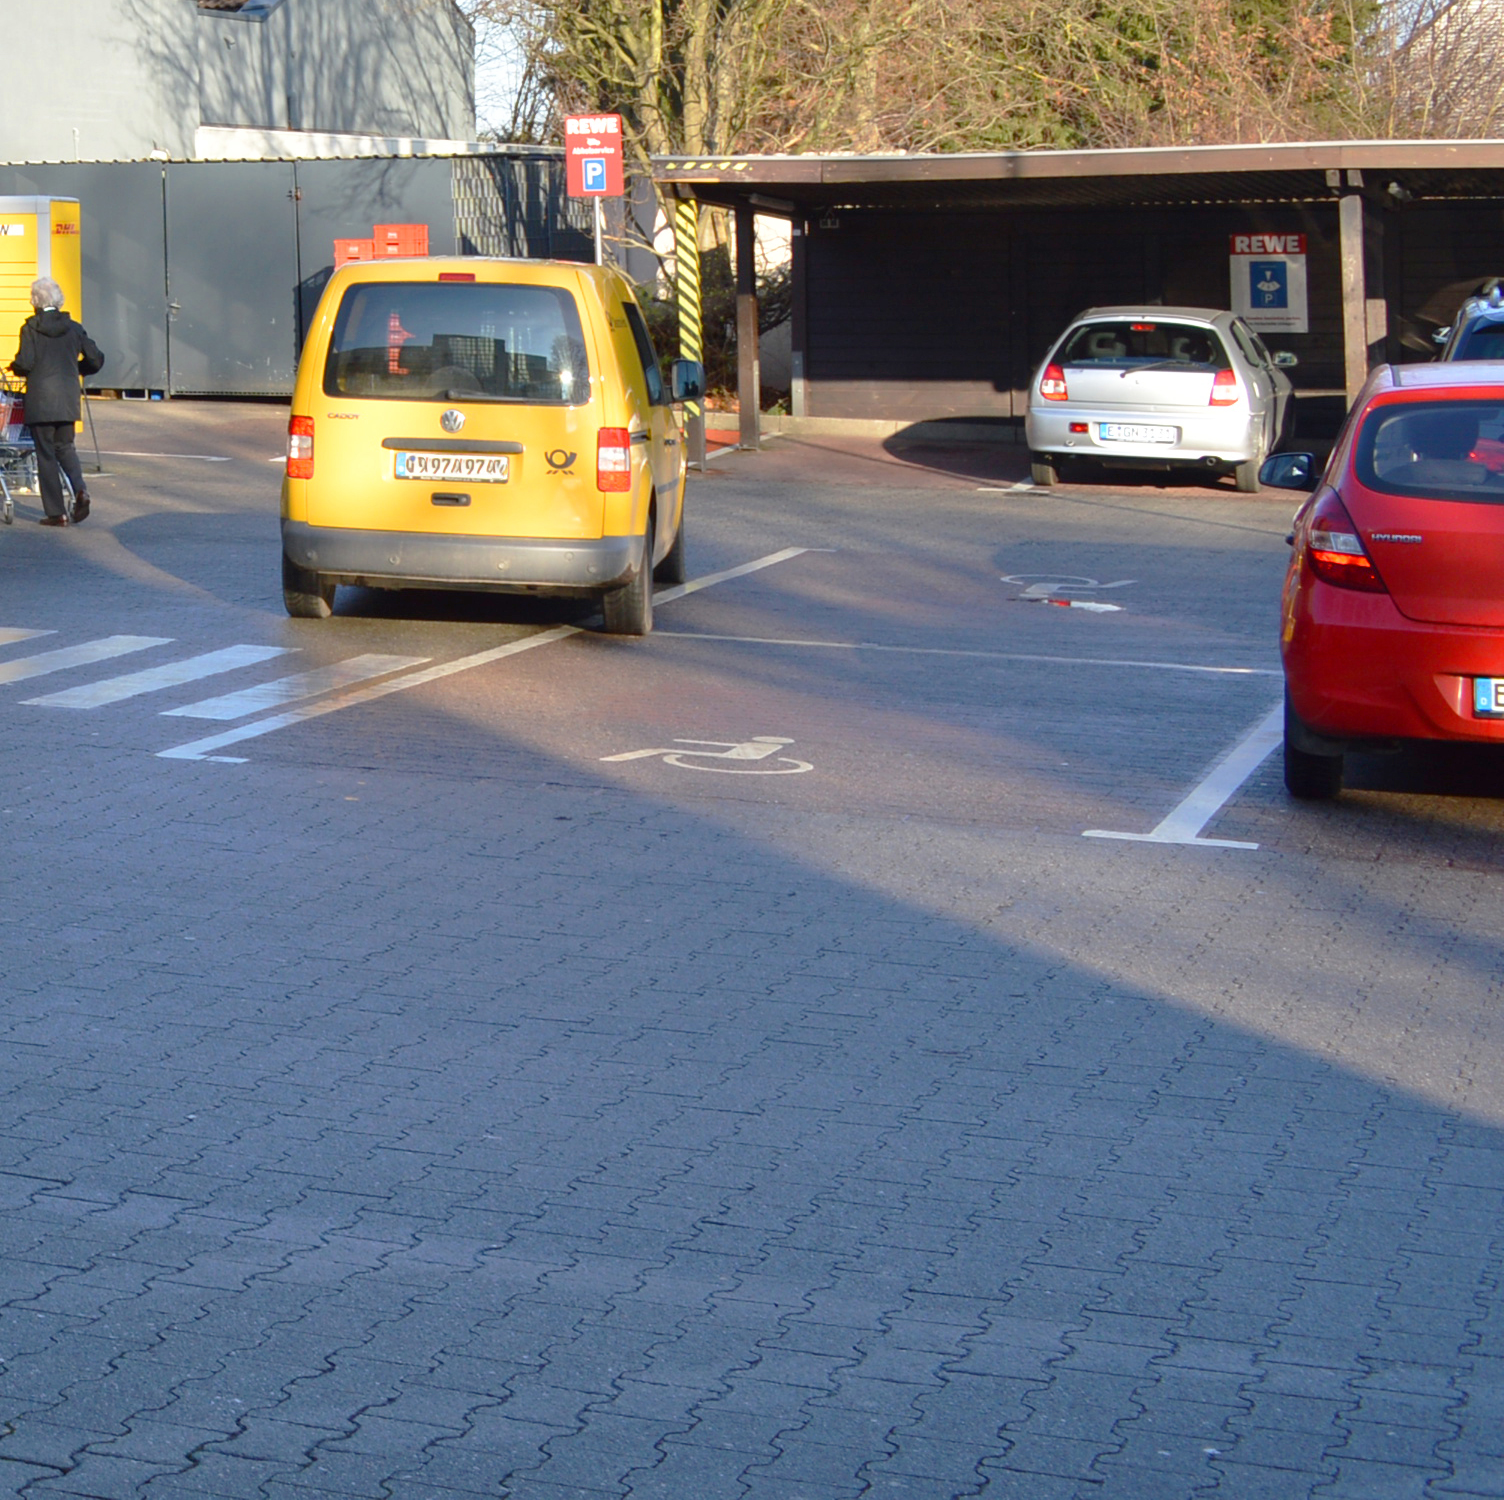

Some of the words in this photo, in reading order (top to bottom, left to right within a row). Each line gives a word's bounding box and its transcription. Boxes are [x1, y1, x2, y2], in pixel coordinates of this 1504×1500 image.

[566, 117, 619, 135] REWE
[586, 162, 603, 186] P
[1235, 235, 1301, 253] REWE
[1265, 293, 1273, 304] P
[1371, 533, 1423, 544] HYUNDAI
